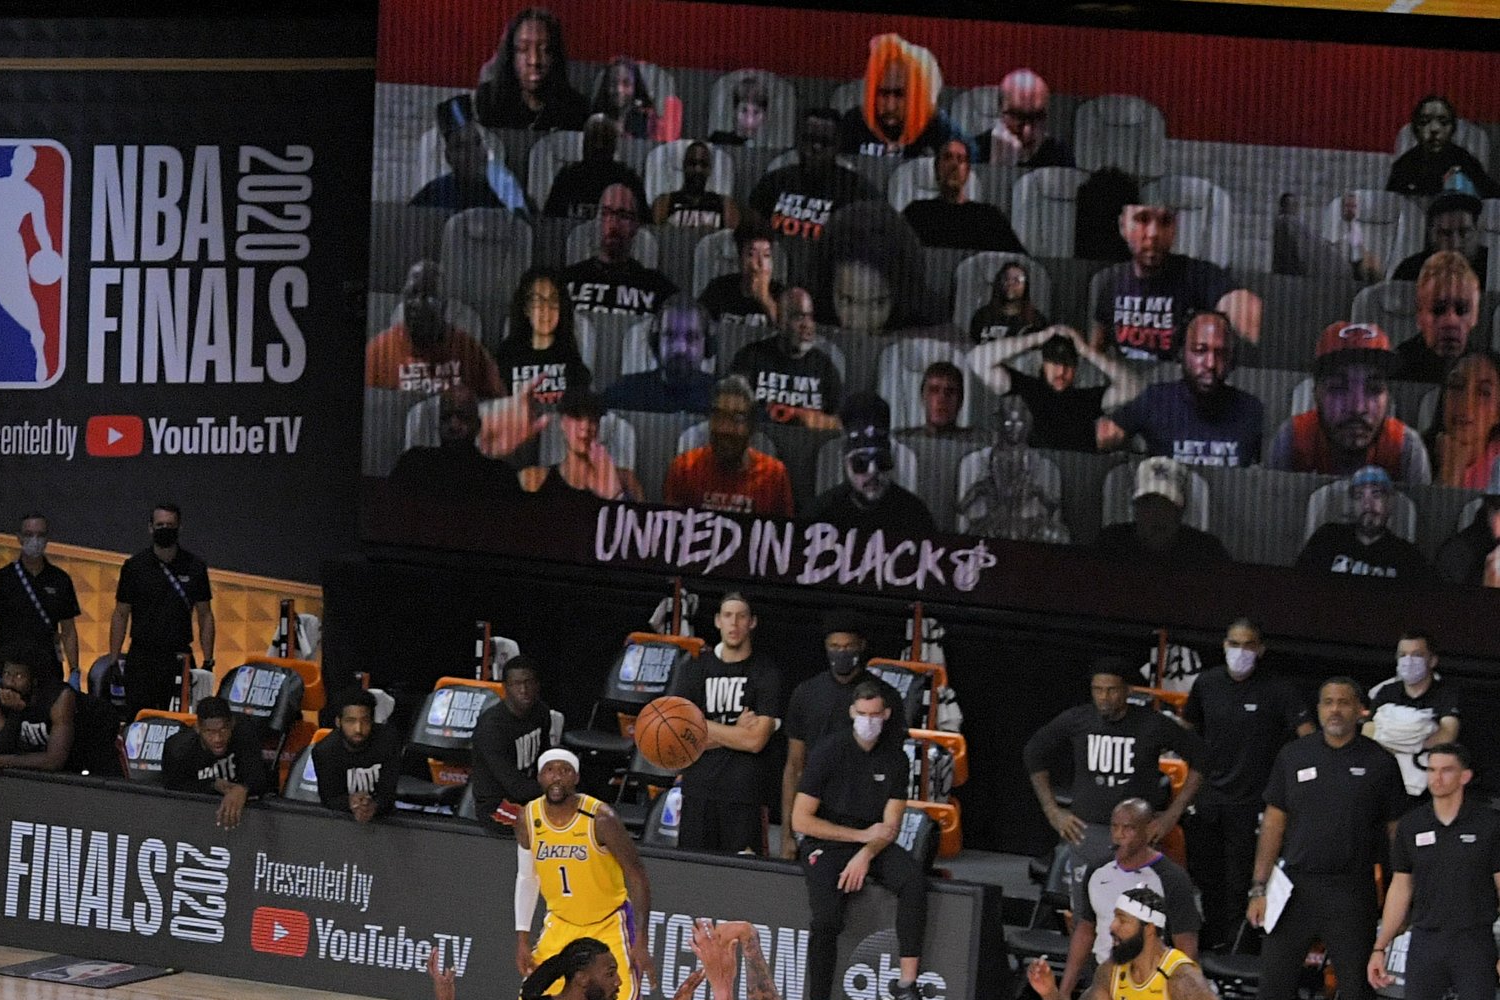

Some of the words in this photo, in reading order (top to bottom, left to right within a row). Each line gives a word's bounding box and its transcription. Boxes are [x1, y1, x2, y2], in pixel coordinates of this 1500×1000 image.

[90, 145, 226, 262] NBA
[235, 145, 314, 262] 2020
[87, 266, 309, 384] FINALS
[757, 371, 790, 391] LET
[793, 376, 821, 393] MY
[56, 417, 78, 460] by
[595, 504, 742, 575] UNITED
[748, 518, 794, 577] IN
[797, 522, 947, 591] BLACK
[706, 677, 748, 713] VOTE
[1087, 734, 1136, 774] VOTE
[536, 840, 588, 861] LAKERS
[5, 821, 167, 937] FINALS
[170, 842, 231, 944] 2020
[255, 852, 348, 903] Presented
[349, 860, 374, 914] by
[558, 864, 573, 897] 1
